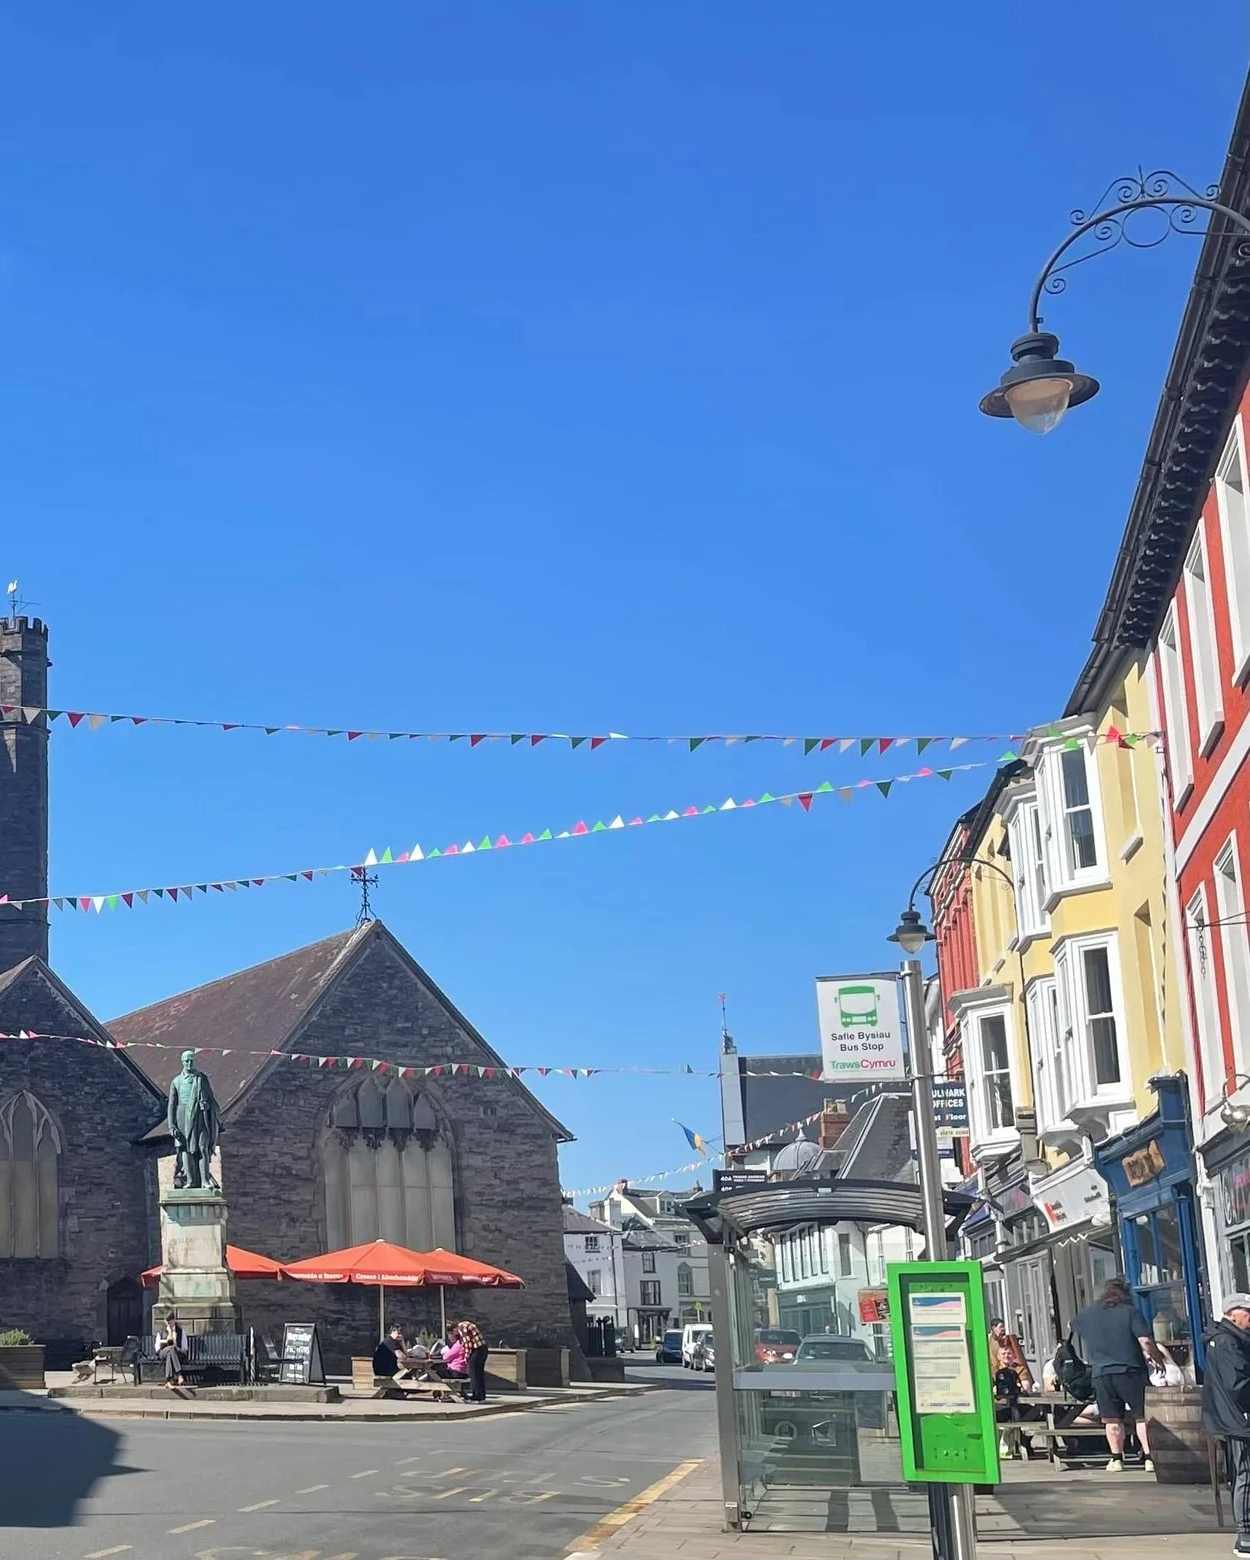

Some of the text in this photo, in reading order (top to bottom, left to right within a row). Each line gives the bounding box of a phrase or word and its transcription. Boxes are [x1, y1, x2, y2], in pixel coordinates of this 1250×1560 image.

[831, 1031, 891, 1041] Safle Bysiau
[840, 1042, 884, 1052] Bus Stop
[830, 1059, 896, 1069] TrawsCymru
[374, 1485, 562, 1505] BUS
